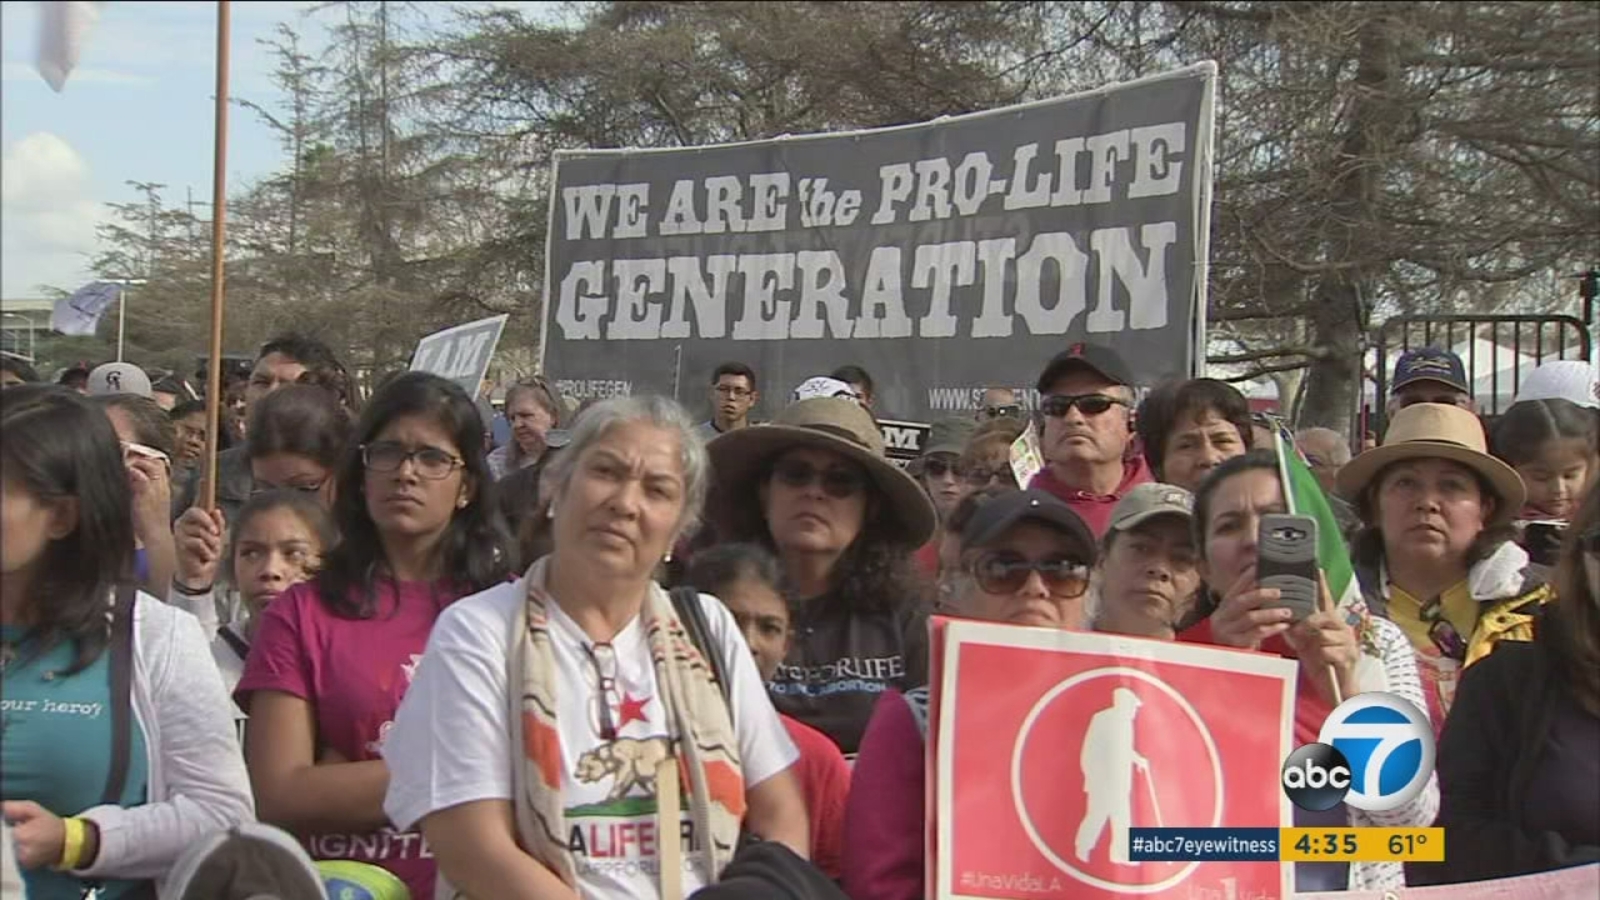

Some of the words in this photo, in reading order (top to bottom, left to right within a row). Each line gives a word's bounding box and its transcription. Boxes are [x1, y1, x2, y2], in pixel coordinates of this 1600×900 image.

[561, 183, 649, 241] WE
[659, 172, 790, 236] ARE
[798, 177, 863, 229] the
[871, 122, 1187, 226] PRO-LIFE
[554, 221, 1177, 342] GENERATION
